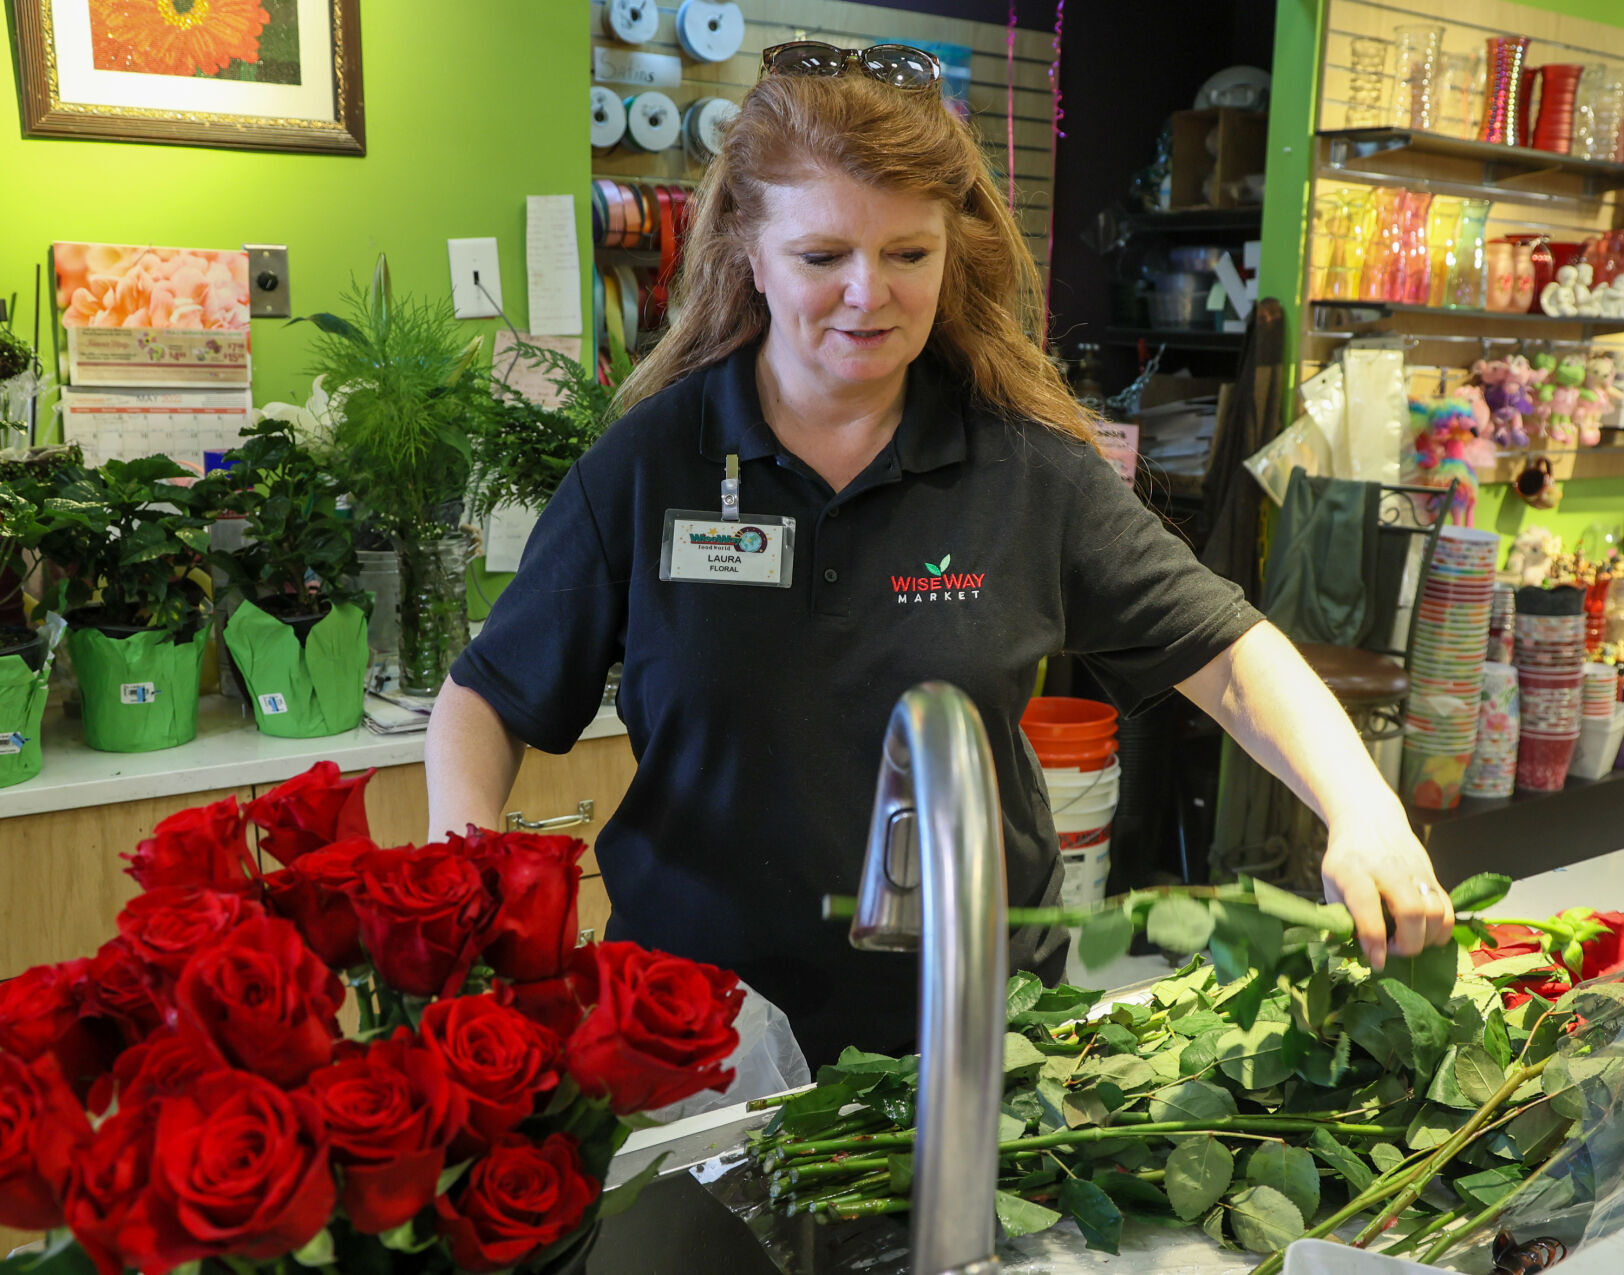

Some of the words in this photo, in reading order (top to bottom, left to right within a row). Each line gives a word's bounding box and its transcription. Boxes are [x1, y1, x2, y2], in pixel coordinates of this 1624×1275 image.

[708, 554, 742, 564] LAURA
[709, 565, 739, 573] FLORAL
[890, 573, 985, 592] WISEWAY
[898, 590, 980, 604] MARKET
